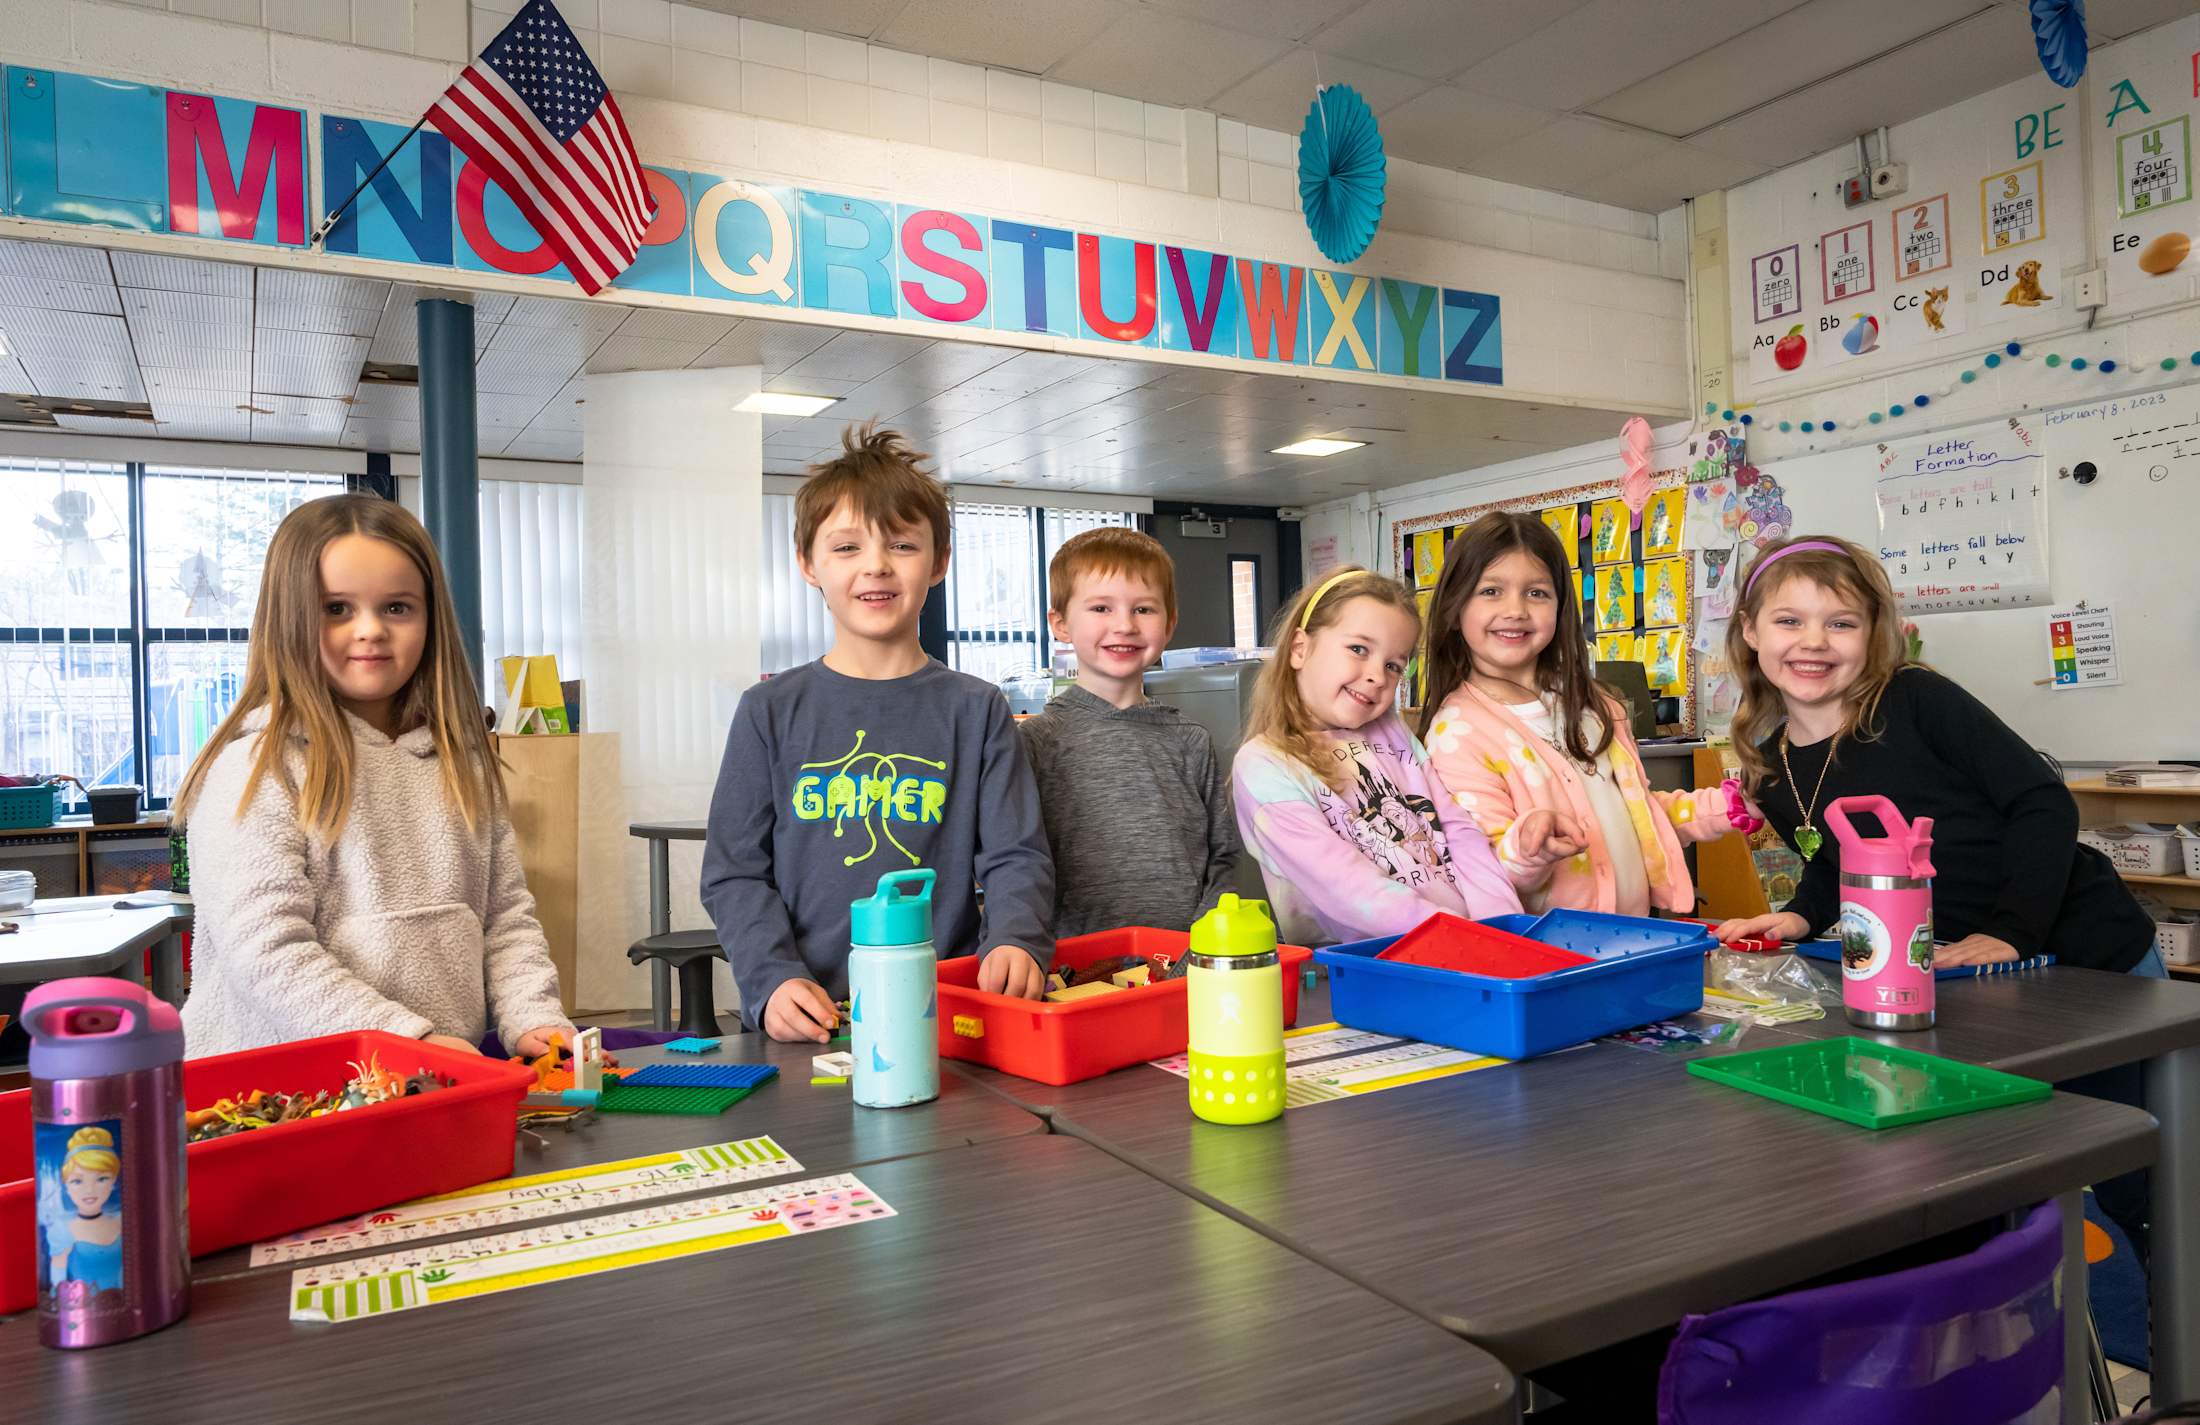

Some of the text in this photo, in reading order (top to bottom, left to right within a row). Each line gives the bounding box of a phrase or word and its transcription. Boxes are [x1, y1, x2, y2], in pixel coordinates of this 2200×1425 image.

[2014, 78, 2152, 160] BE A
[2142, 130, 2163, 155] 4
[2135, 156, 2172, 176] four
[2003, 174, 2020, 199] 3
[1992, 196, 2033, 217] three
[8, 65, 164, 232] L
[165, 91, 306, 245] M
[322, 114, 454, 265] N
[693, 179, 795, 303] Q
[804, 197, 898, 316] R
[900, 210, 988, 322] S
[992, 219, 1073, 331] T
[1077, 232, 1157, 342] U
[1164, 246, 1229, 352] V
[1236, 259, 1305, 361] W
[1312, 269, 1376, 371] X
[1380, 277, 1436, 377] Y
[1444, 290, 1502, 385] Z
[1913, 206, 1929, 230] 2
[1909, 231, 1934, 245] two
[2112, 233, 2140, 252] Ee
[1769, 255, 1783, 276] 0
[1837, 255, 1858, 268] one
[1764, 277, 1790, 291] zero
[1981, 265, 2009, 286] Dd
[1893, 294, 1919, 311] Cc
[1820, 315, 1840, 331] Bb
[1753, 335, 1774, 349] Aa
[2045, 405, 2107, 426] February
[2131, 393, 2167, 409] 2023
[1927, 439, 1976, 456] Letter
[1915, 450, 1998, 472] Formation
[1902, 503, 1910, 516] b
[1919, 501, 1927, 513] d
[1939, 497, 1947, 510] f
[1956, 497, 1963, 508] h
[1991, 491, 1999, 503] k
[1212, 525, 1221, 534] 3
[1880, 533, 2026, 560] Some letters fall below
[1900, 551, 2014, 575] g j p q y
[1917, 583, 1952, 597] letters
[1959, 585, 1976, 593] are
[2072, 609, 2090, 617] Level
[2056, 621, 2105, 633] 4 Shouting
[2059, 636, 2066, 645] 3
[2076, 645, 2111, 654] Speaking
[2080, 658, 2109, 667] Whisper
[2063, 671, 2107, 682] 0 Silent
[792, 774, 947, 825] GAMER
[1877, 990, 1916, 1002] YETI
[509, 1182, 584, 1201] Ruby
